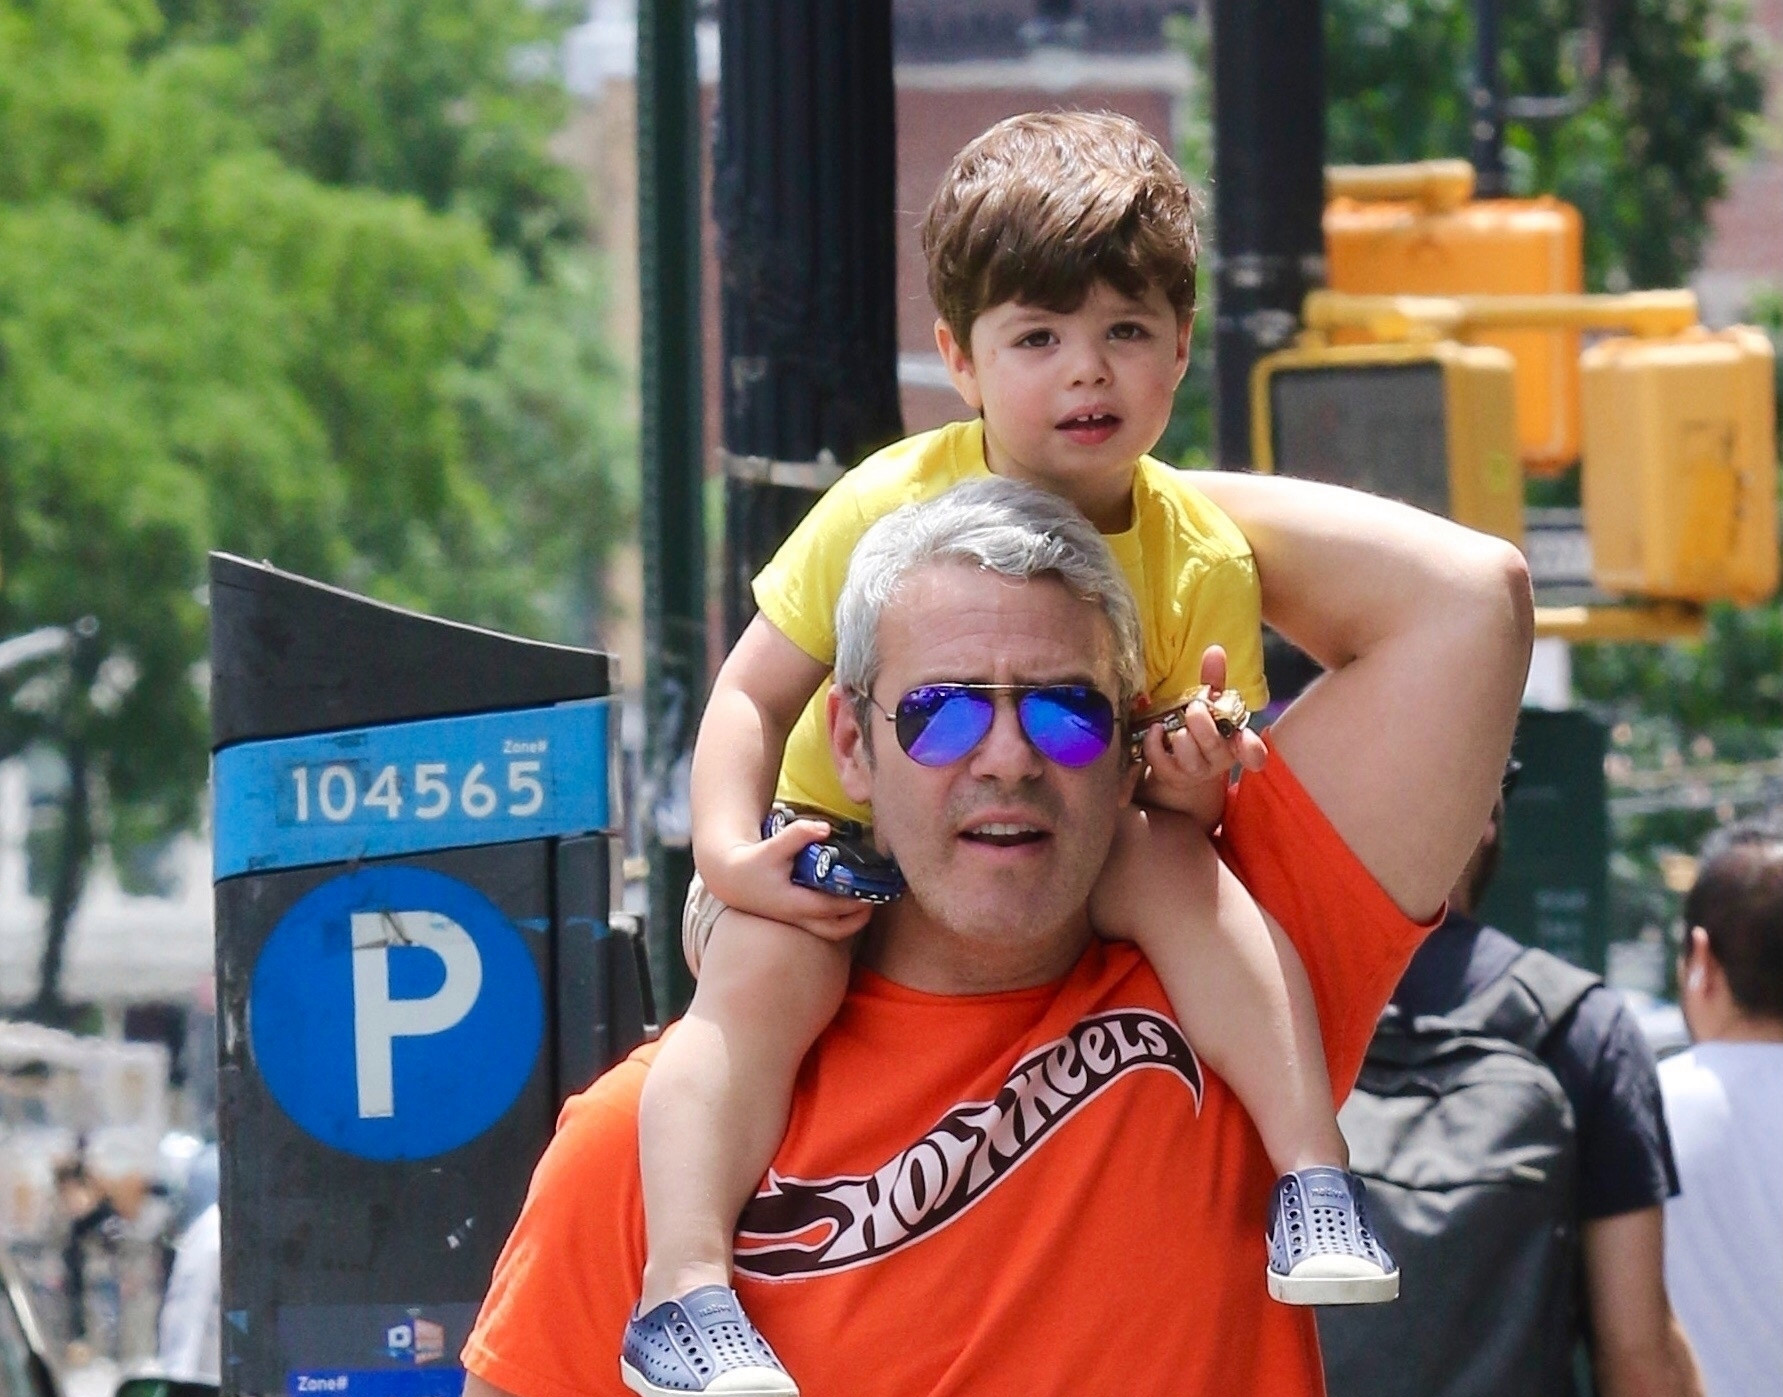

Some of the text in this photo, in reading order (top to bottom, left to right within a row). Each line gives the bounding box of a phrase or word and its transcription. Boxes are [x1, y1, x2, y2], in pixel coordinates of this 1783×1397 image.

[292, 760, 545, 823] 104565
[350, 910, 483, 1119] P
[816, 1130, 978, 1263] HOT
[297, 1375, 349, 1392] Zone#
